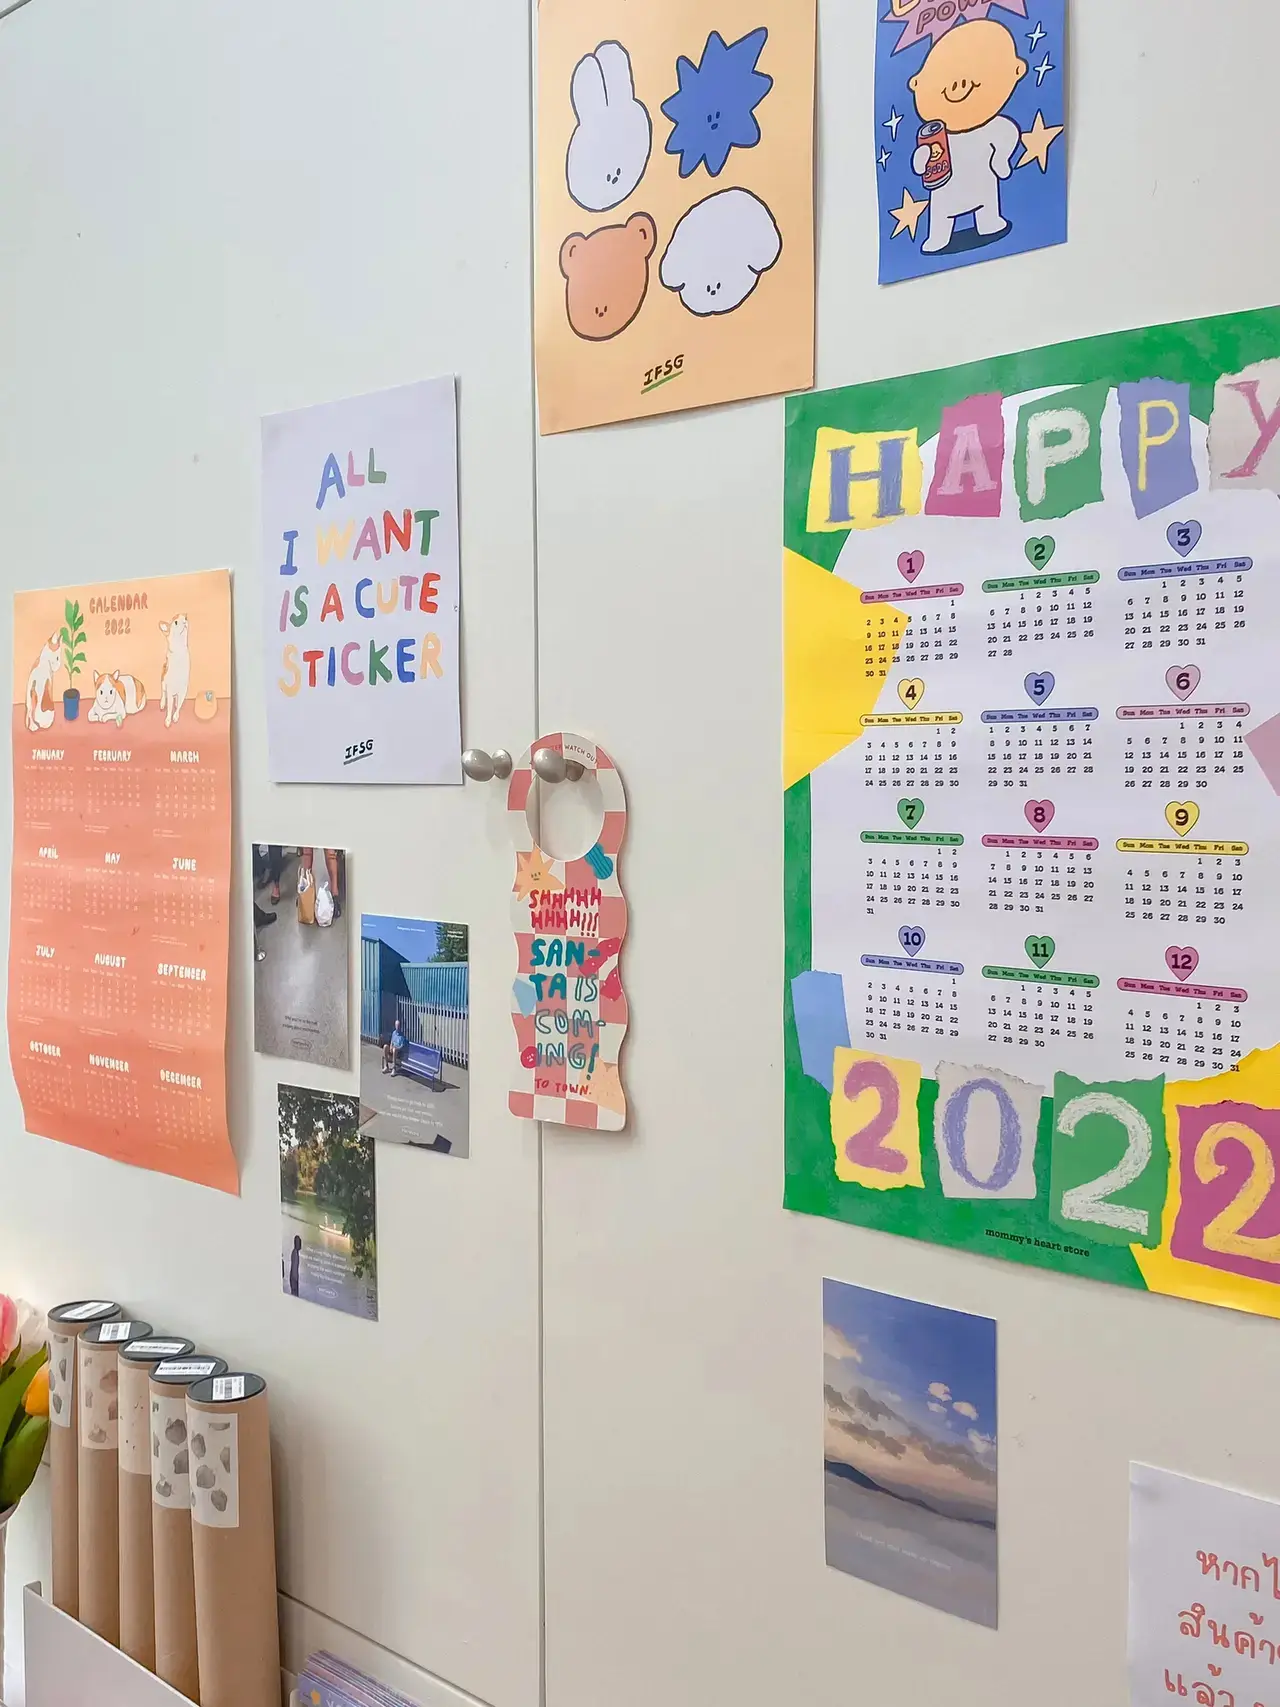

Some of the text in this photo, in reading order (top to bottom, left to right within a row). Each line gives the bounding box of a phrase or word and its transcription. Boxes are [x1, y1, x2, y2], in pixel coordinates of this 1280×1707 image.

[924, 160, 948, 178] SODA
[644, 354, 684, 386] IFSG
[316, 448, 386, 510] ALL
[280, 509, 440, 575] I WANT
[1177, 529, 1190, 546] 3
[1034, 544, 1045, 560] 2
[906, 558, 915, 574] 1
[1236, 575, 1242, 583] 5
[90, 592, 148, 614] CALENDAR
[280, 572, 441, 632] IS A CUTE
[1196, 592, 1206, 601] 10
[1215, 591, 1225, 599] 11
[1234, 590, 1244, 598] 12
[1124, 605, 1244, 620] 13 14 15 16 17 18 19
[104, 618, 130, 636] 2022
[1178, 624, 1189, 632] 23
[1196, 622, 1207, 630] 24
[1215, 621, 1226, 630] 25
[1234, 620, 1246, 628] 26
[1142, 640, 1153, 648] 28
[1160, 640, 1171, 648] 29
[1178, 638, 1190, 646] 30
[1196, 638, 1206, 646] 31
[278, 632, 444, 697] STICKER
[1034, 680, 1045, 696] 5
[1176, 674, 1190, 690] 6
[905, 685, 916, 700] 4
[32, 749, 64, 760] JANUARY
[170, 750, 200, 763] MARCH
[344, 738, 374, 758] IFSG
[564, 744, 585, 754] WATCH
[905, 805, 916, 820] 7
[1034, 807, 1045, 823] 8
[1174, 809, 1188, 826] 9
[105, 852, 120, 864] MAY
[172, 858, 196, 871] JUNE
[904, 932, 921, 946] 10
[36, 945, 55, 958] JULY
[530, 939, 600, 967] SAN-
[1032, 944, 1049, 958] 11
[94, 953, 126, 968] AUGUST
[1171, 954, 1192, 970] 12
[157, 964, 206, 981] SEPTEMBER
[530, 974, 598, 1002] TA IS
[534, 1008, 606, 1037] COM-
[1231, 1020, 1241, 1028] 10
[1142, 1024, 1152, 1032] 12
[1212, 1032, 1222, 1041] 16
[1230, 1035, 1240, 1043] 17
[30, 1041, 62, 1058] OCTOBER
[1125, 1036, 1135, 1044] 18
[1160, 1040, 1171, 1048] 20
[1177, 1043, 1186, 1051] 21
[1194, 1045, 1205, 1053] 22
[1212, 1047, 1223, 1055] 23
[1230, 1049, 1242, 1058] 24
[89, 1054, 130, 1073] NOVEMBER
[534, 1043, 600, 1080] ING!
[1125, 1050, 1240, 1072] 25 26 27 28 29 30 31
[160, 1070, 202, 1090] DECEMBER
[534, 1078, 592, 1096] TO TOWN.
[843, 1060, 1280, 1263] 2022
[985, 1228, 1090, 1256] mommy's heart store
